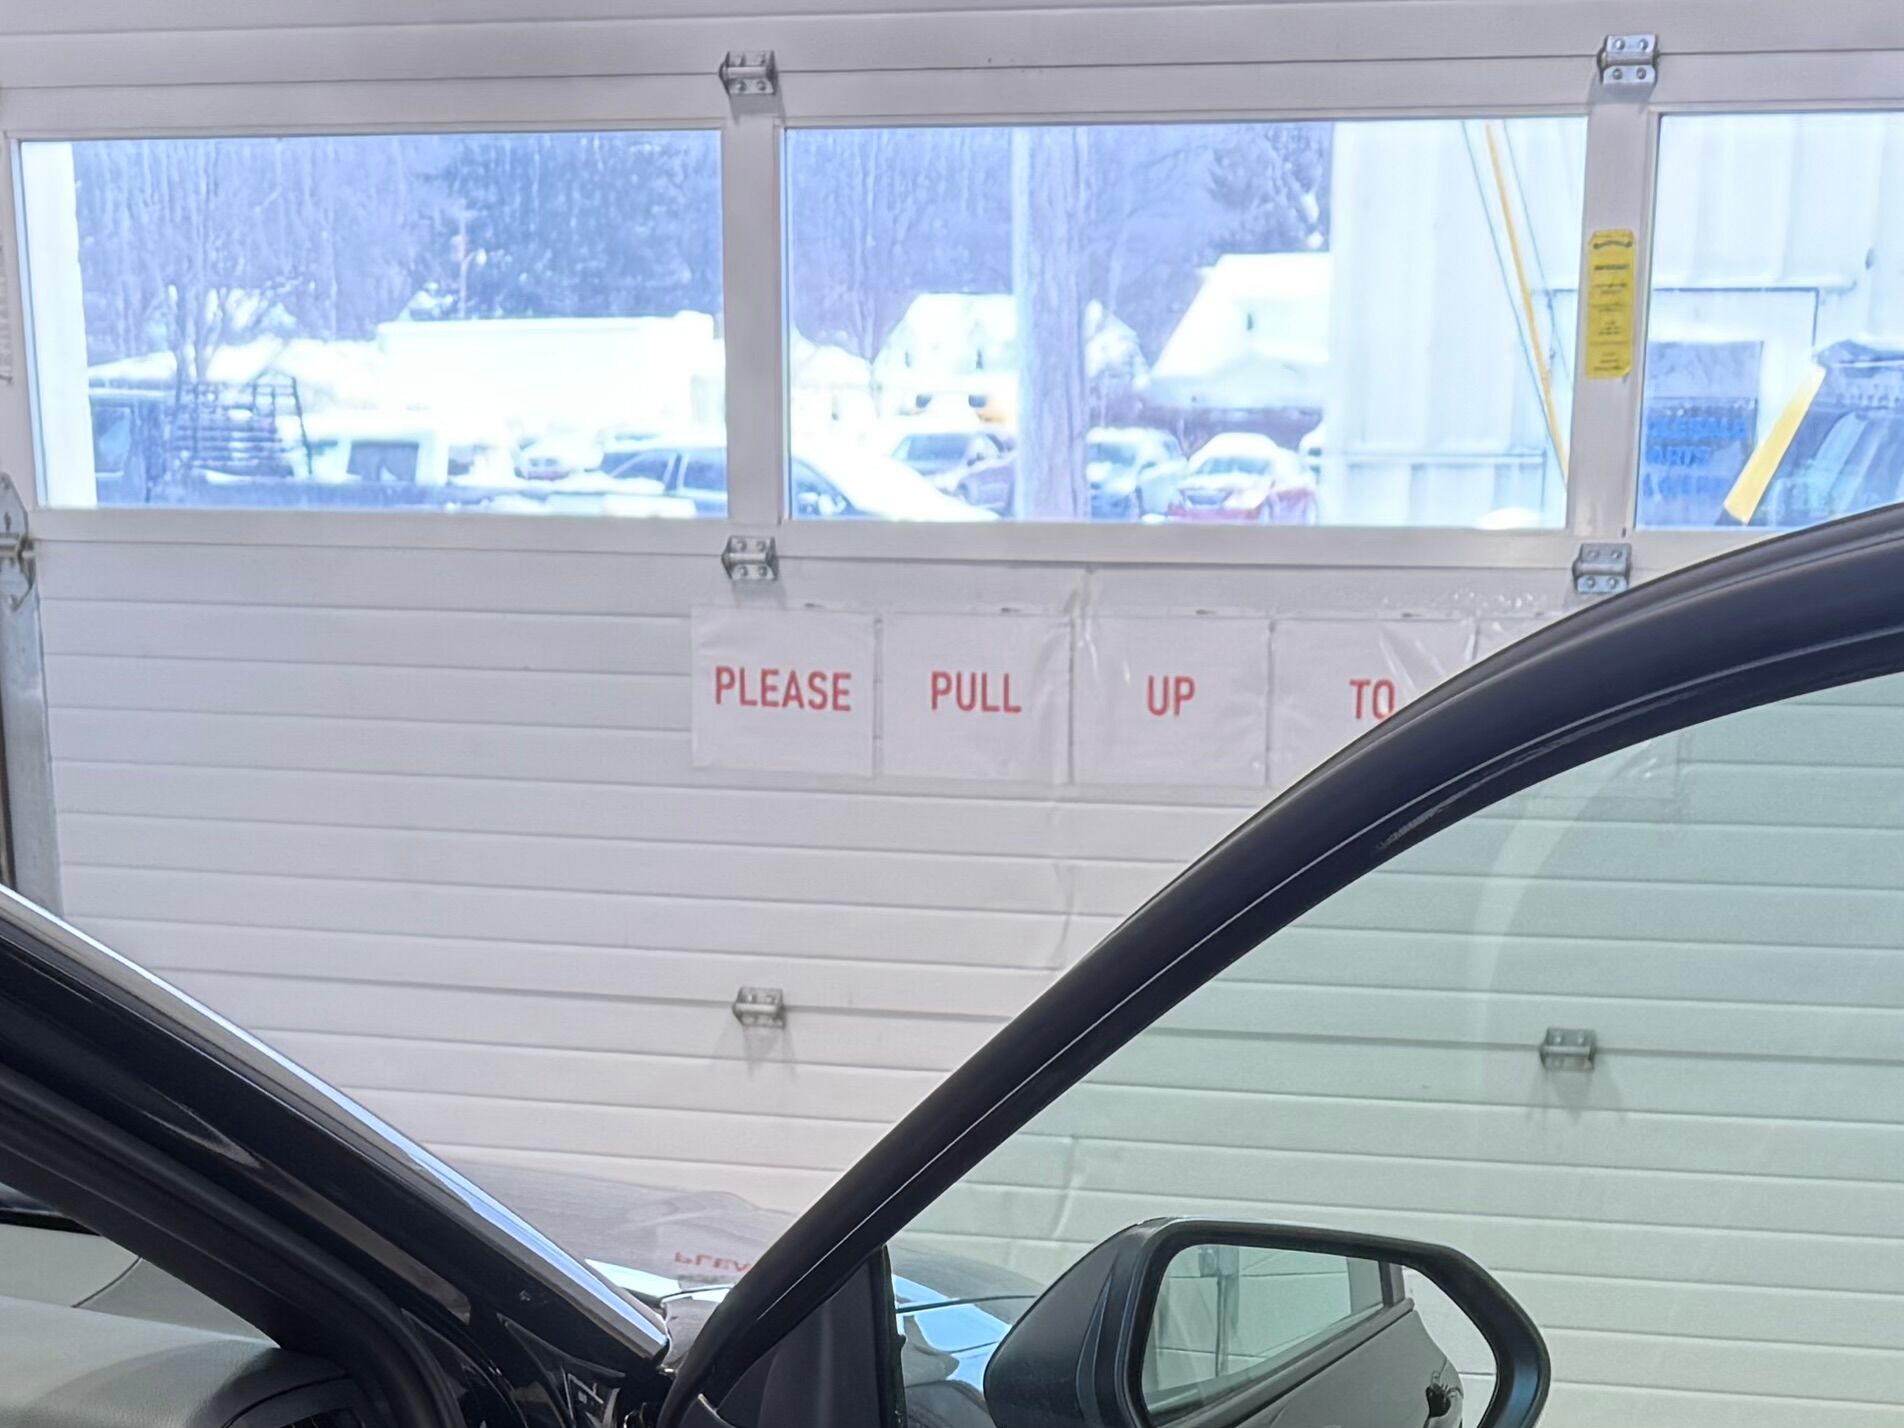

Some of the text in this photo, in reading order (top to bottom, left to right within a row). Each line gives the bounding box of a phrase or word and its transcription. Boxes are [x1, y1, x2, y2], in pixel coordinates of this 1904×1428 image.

[714, 665, 1397, 721] PLEASE PULL UP TO
